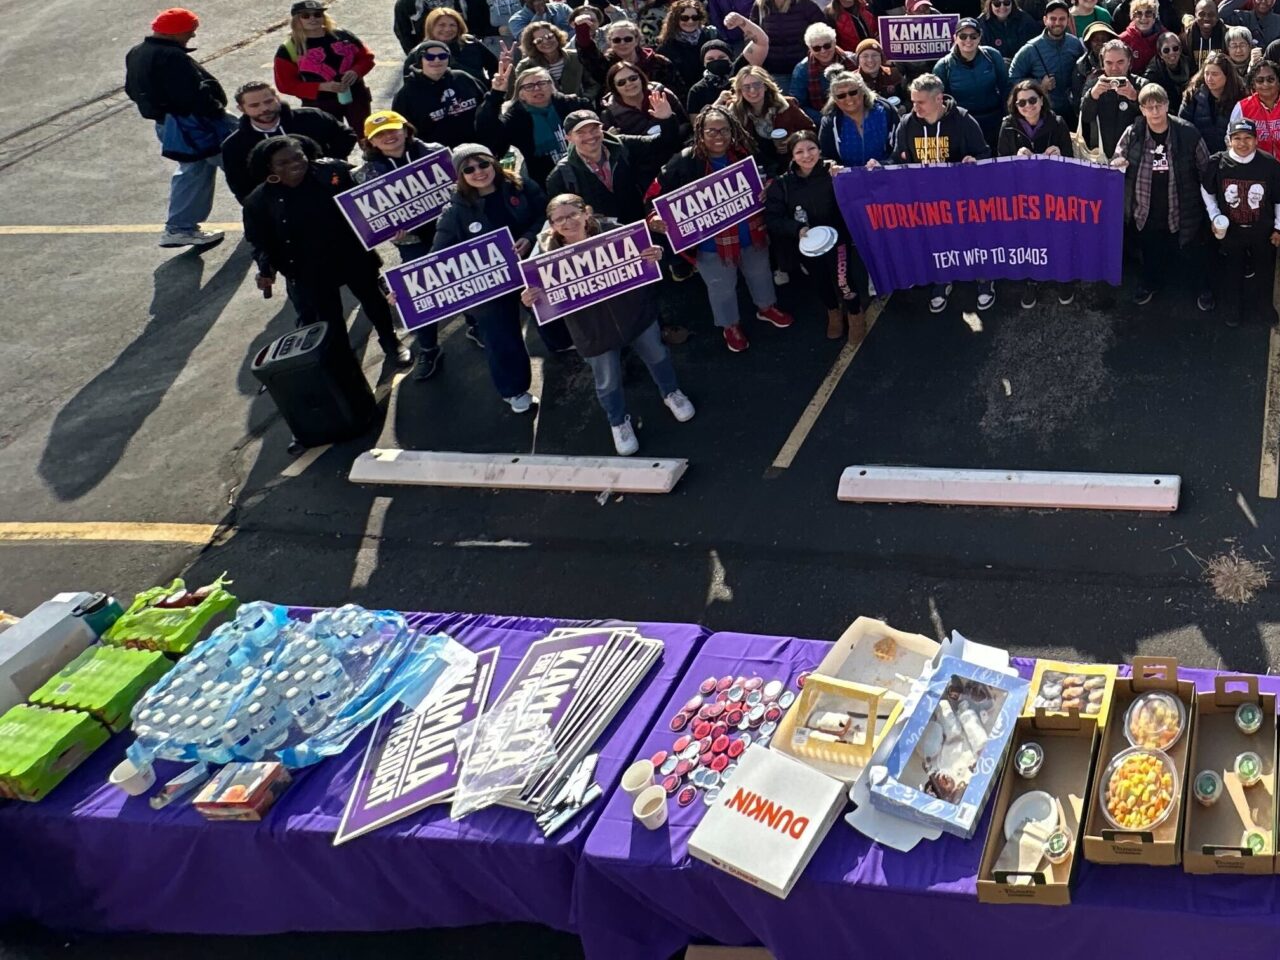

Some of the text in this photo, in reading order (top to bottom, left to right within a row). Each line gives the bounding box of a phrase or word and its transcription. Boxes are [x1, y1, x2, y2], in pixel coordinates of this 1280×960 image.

[888, 22, 951, 41] KAMALA
[890, 41, 952, 54] FOR PRESIDENT
[914, 136, 950, 149] WORKNG
[915, 147, 950, 160] FAMILES
[354, 162, 451, 219] KAMALA
[669, 171, 751, 222] KAMALA
[865, 194, 1102, 231] WORKING FAMILIES PARTY
[369, 216, 390, 232] FOR
[679, 223, 696, 237] FOR
[695, 192, 755, 231] PRESIDENT
[403, 242, 506, 297] KAMALA
[538, 236, 640, 289] KAMALA
[933, 246, 1048, 270] TEXT WFP TO 30403
[413, 266, 511, 313] FOR PRESIDENT
[547, 260, 644, 305] FOR PRESIDENT
[528, 652, 557, 677] FOR
[487, 646, 594, 775] KAMALA
[724, 787, 810, 840] DUNKIN'
